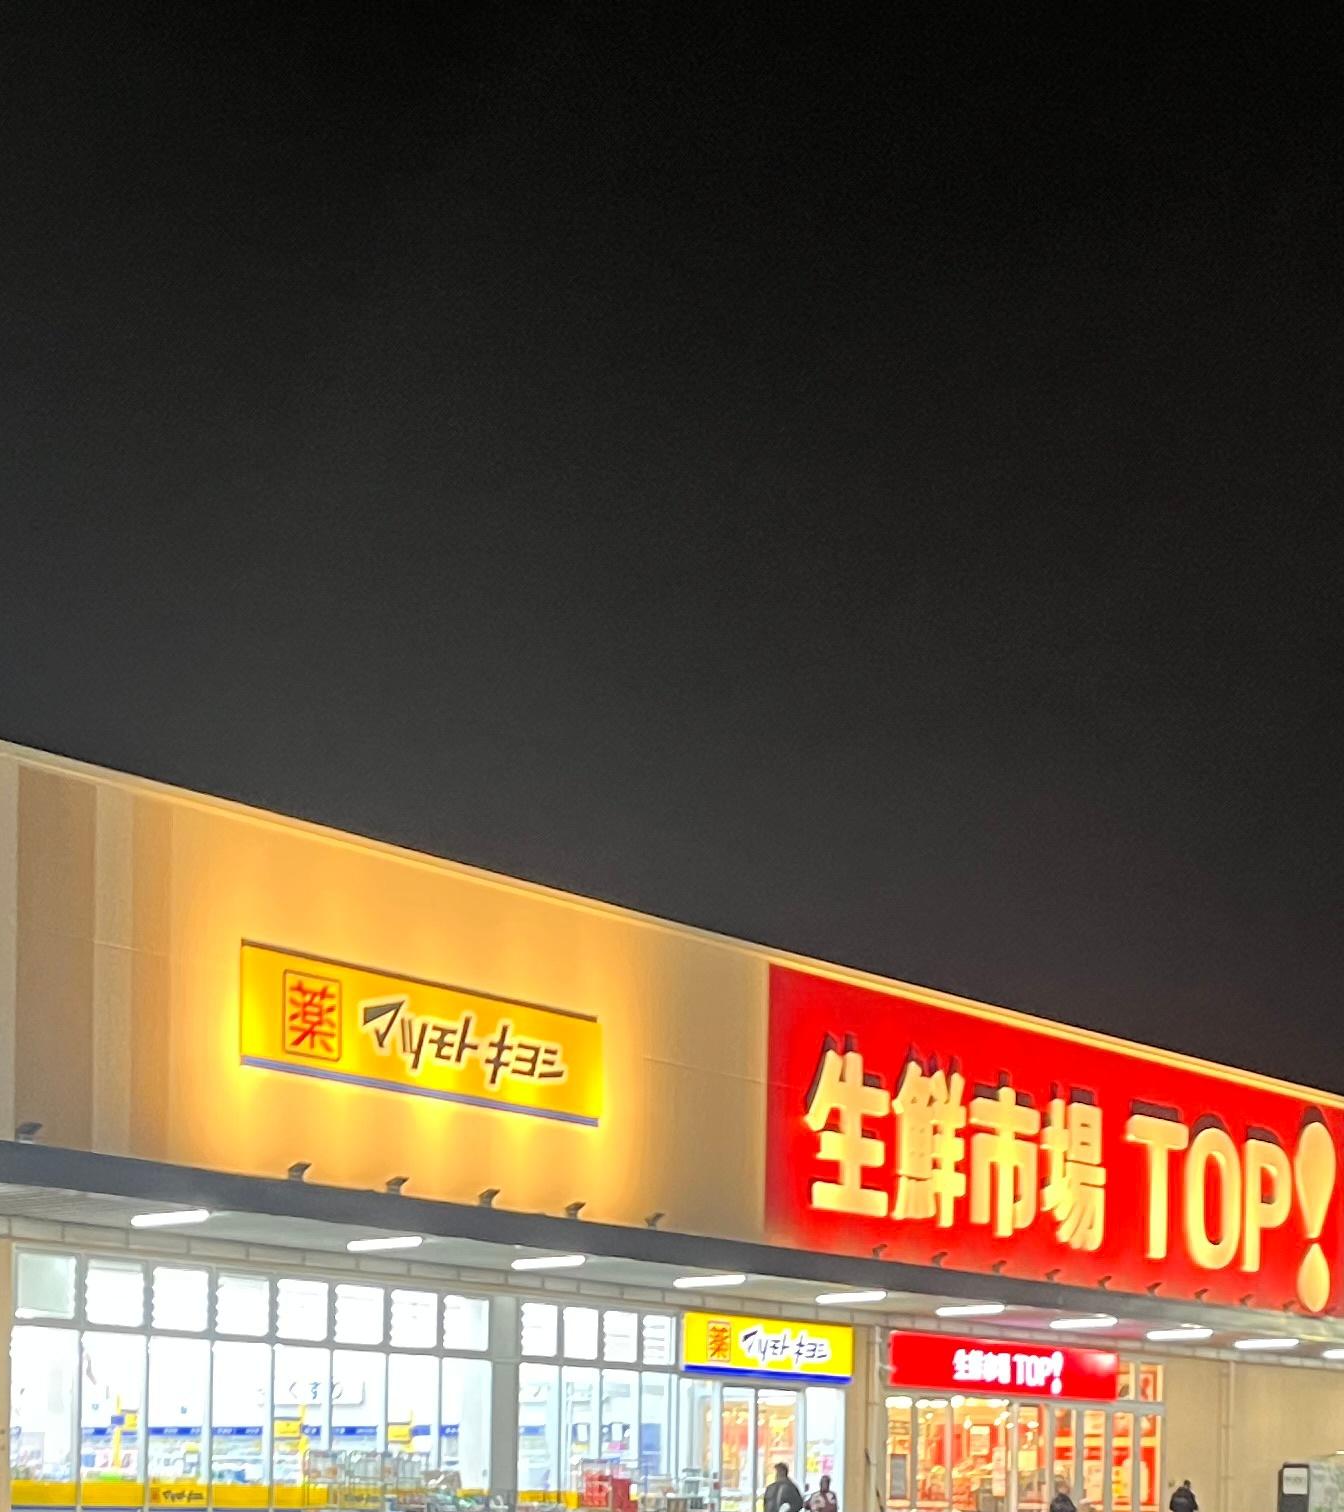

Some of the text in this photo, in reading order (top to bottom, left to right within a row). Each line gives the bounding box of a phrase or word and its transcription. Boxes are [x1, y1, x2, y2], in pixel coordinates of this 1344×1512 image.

[289, 980, 565, 1084] 薬 マツモトキヨシ
[805, 1049, 1337, 1313] 生鮮市場 TOP!
